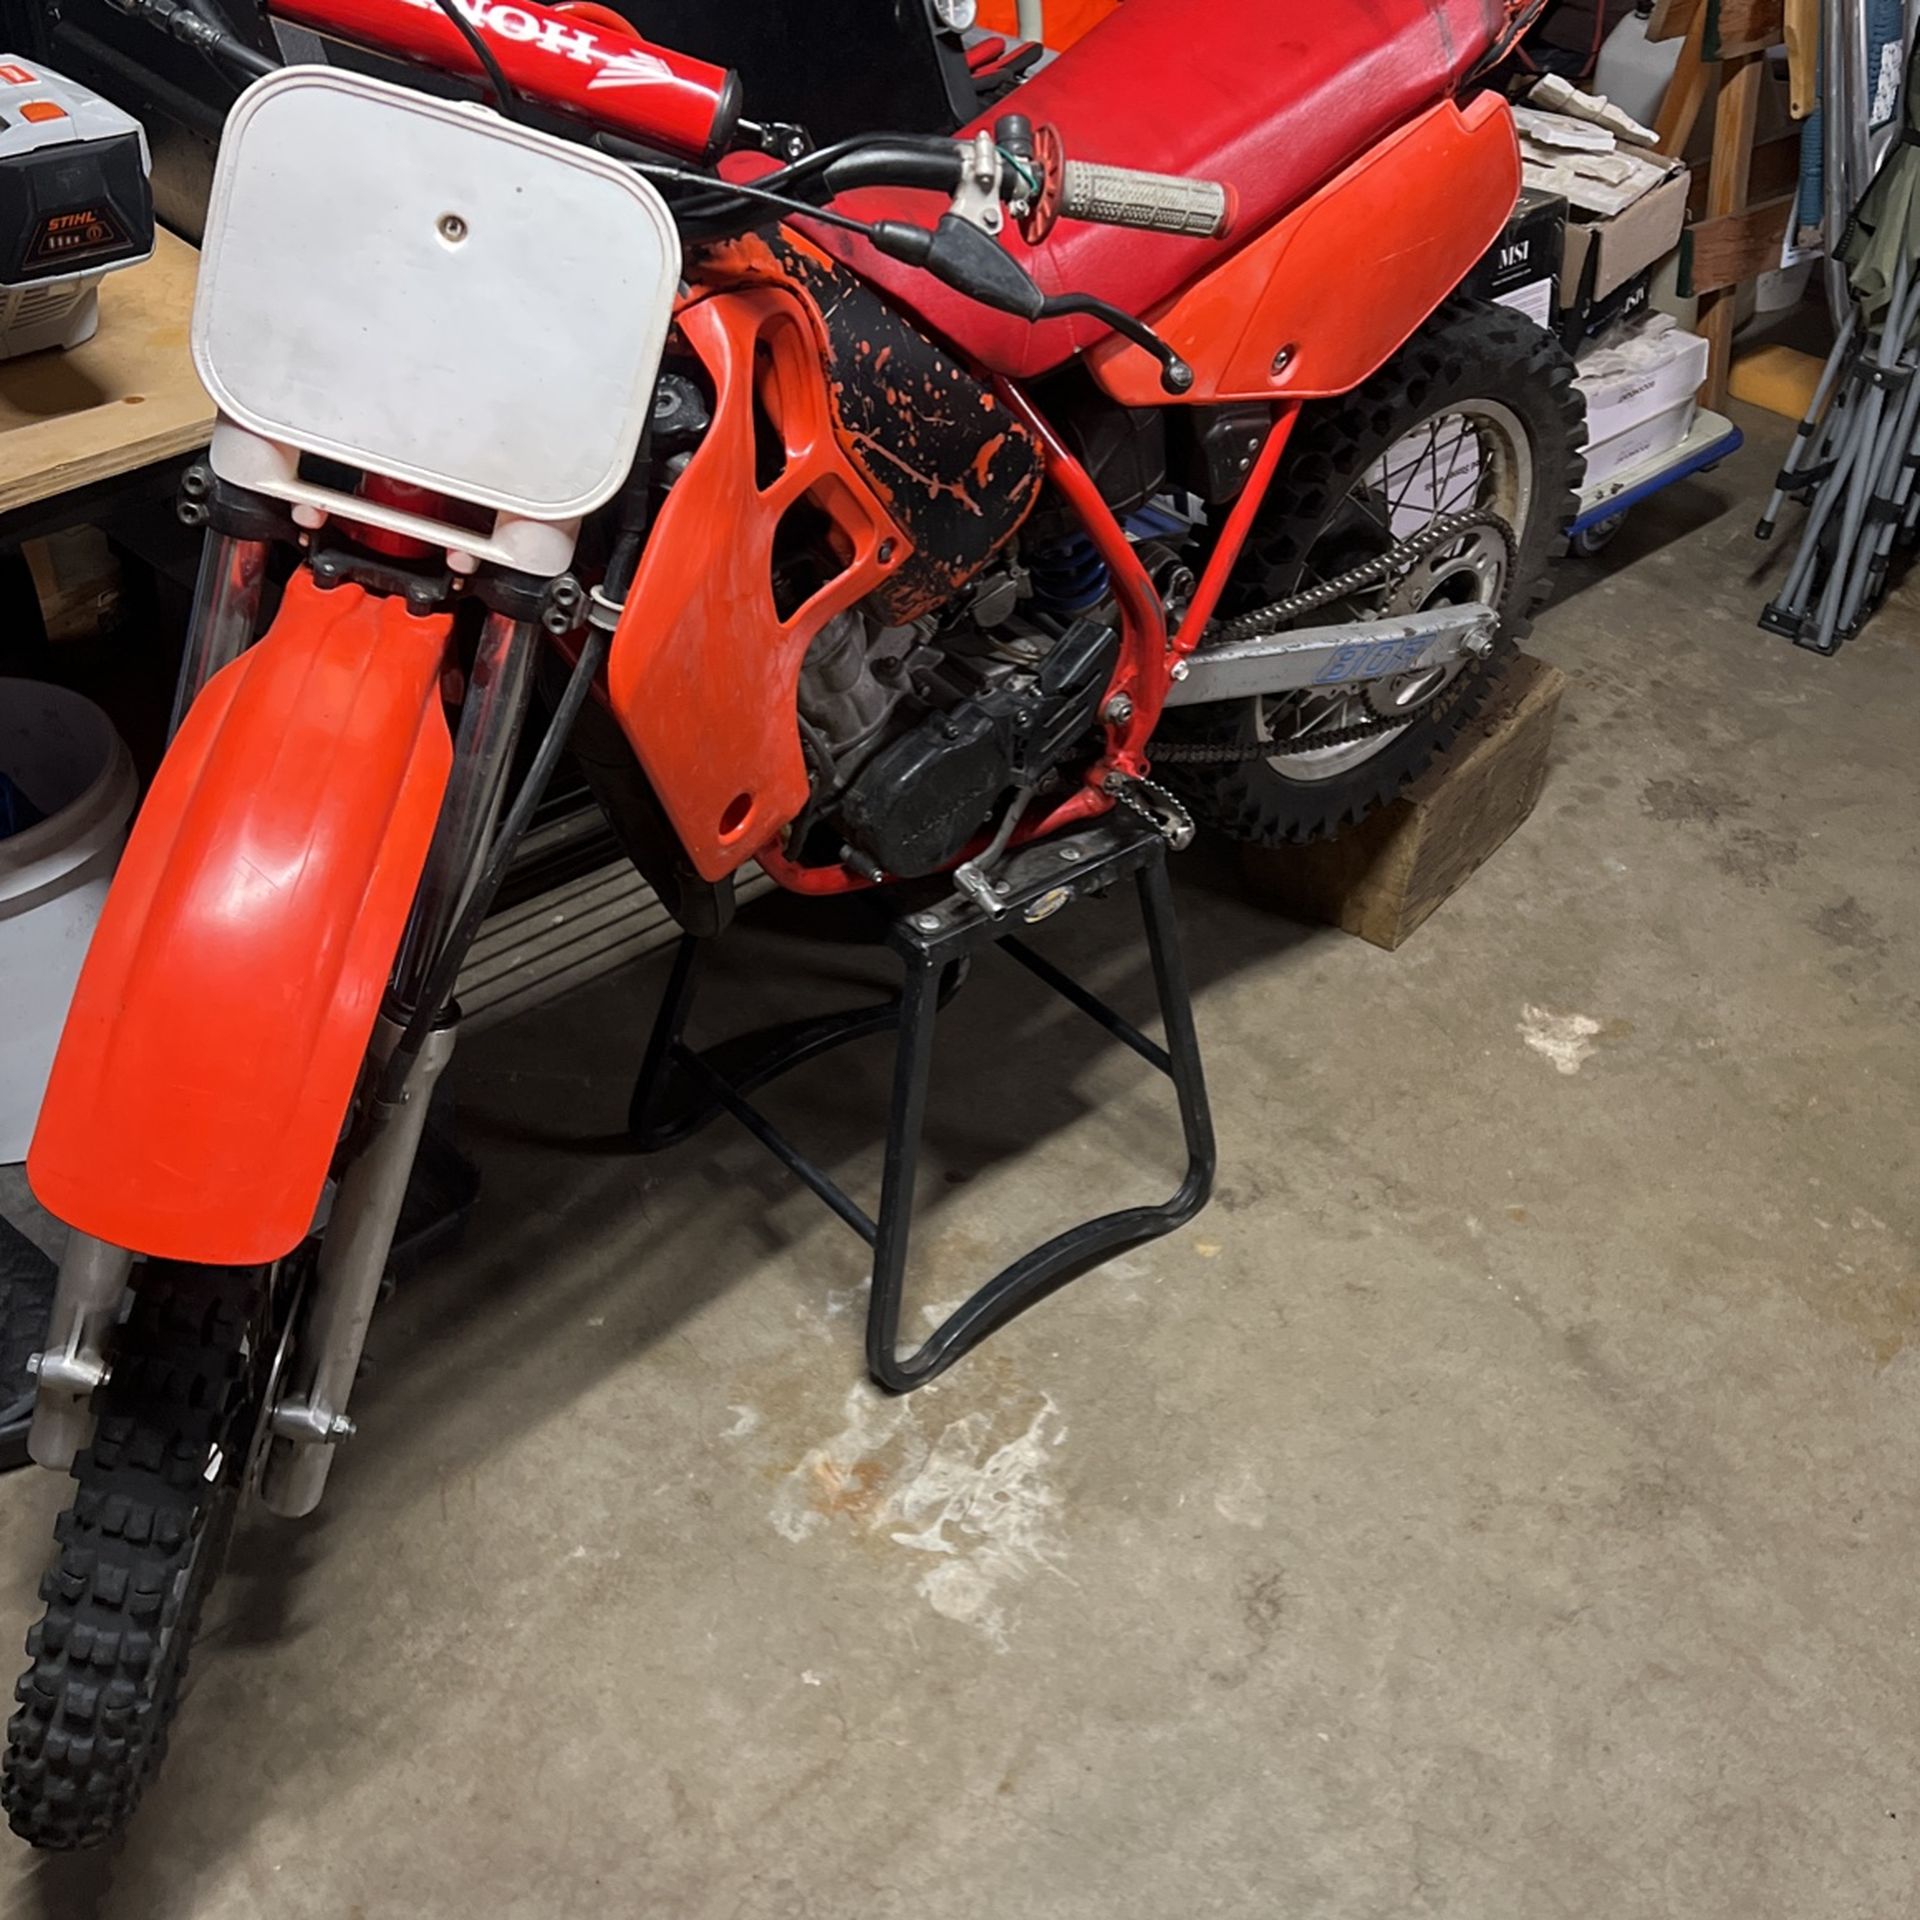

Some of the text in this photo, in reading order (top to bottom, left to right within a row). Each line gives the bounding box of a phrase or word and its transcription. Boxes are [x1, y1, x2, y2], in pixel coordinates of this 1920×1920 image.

[400, 0, 598, 64] HON
[48, 210, 97, 232] STIHL
[1498, 240, 1530, 269] MSI
